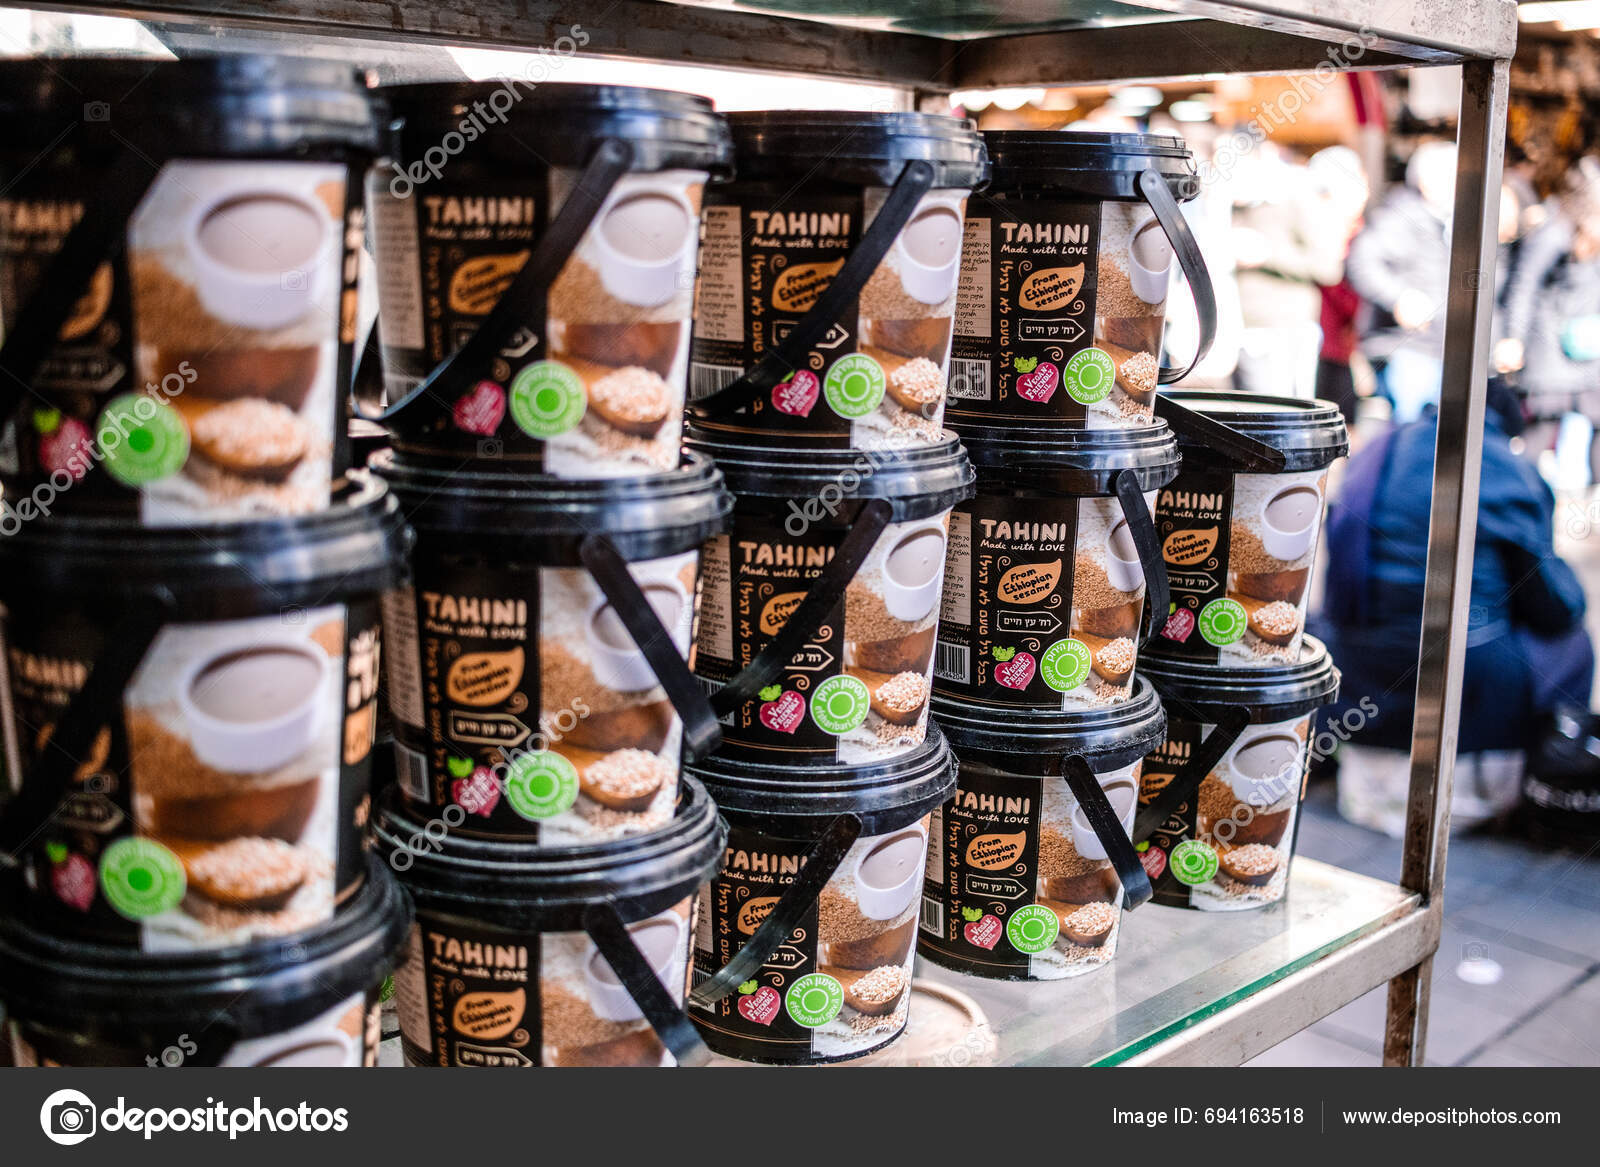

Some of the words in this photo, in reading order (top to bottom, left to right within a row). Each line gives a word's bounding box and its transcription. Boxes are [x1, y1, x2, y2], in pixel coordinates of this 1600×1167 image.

[424, 196, 535, 225] TAHINI
[749, 211, 850, 237] TAHINI
[1000, 222, 1089, 244] TAHINI
[751, 236, 781, 248] Made
[785, 237, 814, 249] with
[1000, 243, 1028, 254] Made
[1032, 245, 1057, 254] with
[1061, 246, 1089, 255] LOVE
[999, 260, 1014, 292] רגיל!
[1032, 273, 1059, 288] From
[1024, 277, 1076, 302] Ethiopian
[1035, 287, 1073, 307] sesame
[999, 297, 1012, 314] לא
[1000, 319, 1009, 346] טעם
[1025, 326, 1045, 334] חיים
[1047, 326, 1059, 336] עץ
[1062, 326, 1075, 334] רח'
[1023, 364, 1049, 389] VEGAN-
[1025, 368, 1055, 401] FRIENDLY
[999, 374, 1012, 401] בכל
[1158, 490, 1223, 511] AHINI
[1173, 510, 1194, 519] with
[1198, 512, 1222, 521] LOVE
[980, 518, 1067, 542] TAHINI
[1172, 533, 1196, 545] From
[980, 540, 1006, 550] Made
[1011, 543, 1035, 552] with
[1039, 543, 1065, 552] LOVE
[1166, 537, 1211, 557] Ethiopian
[1175, 546, 1208, 562] sesame
[740, 564, 769, 577] Made
[772, 569, 800, 578] with
[805, 569, 823, 578] LO
[978, 554, 993, 585] רגיל!
[1010, 567, 1037, 581] From
[1002, 572, 1053, 595] Ethiopian
[1013, 582, 1050, 601] sesame
[979, 588, 991, 606] לא
[422, 591, 527, 626] TAHINI
[979, 609, 988, 636] טעם
[1003, 617, 1024, 626] חיים
[1025, 617, 1037, 627] עץ
[1038, 617, 1052, 627] רח'
[977, 660, 990, 687] בכל
[1001, 653, 1026, 676] VEGAN-
[1005, 657, 1032, 687] FRIENDLY
[955, 789, 1030, 815] TAHINI
[950, 806, 973, 819] Made
[977, 813, 999, 823] with
[1004, 815, 1029, 824] LOVE
[970, 843, 1018, 861] Ethiopian
[977, 838, 1002, 850] From
[949, 851, 961, 868] לא
[979, 852, 1015, 867] sesame
[720, 868, 745, 880] Made
[749, 875, 774, 884] with
[779, 876, 794, 885] LO
[950, 870, 959, 896] טעם
[971, 880, 991, 890] חיים
[991, 882, 1002, 892] עץ
[1003, 883, 1017, 893] רח'
[949, 918, 961, 941] בכל
[428, 931, 528, 969] TAHINI
